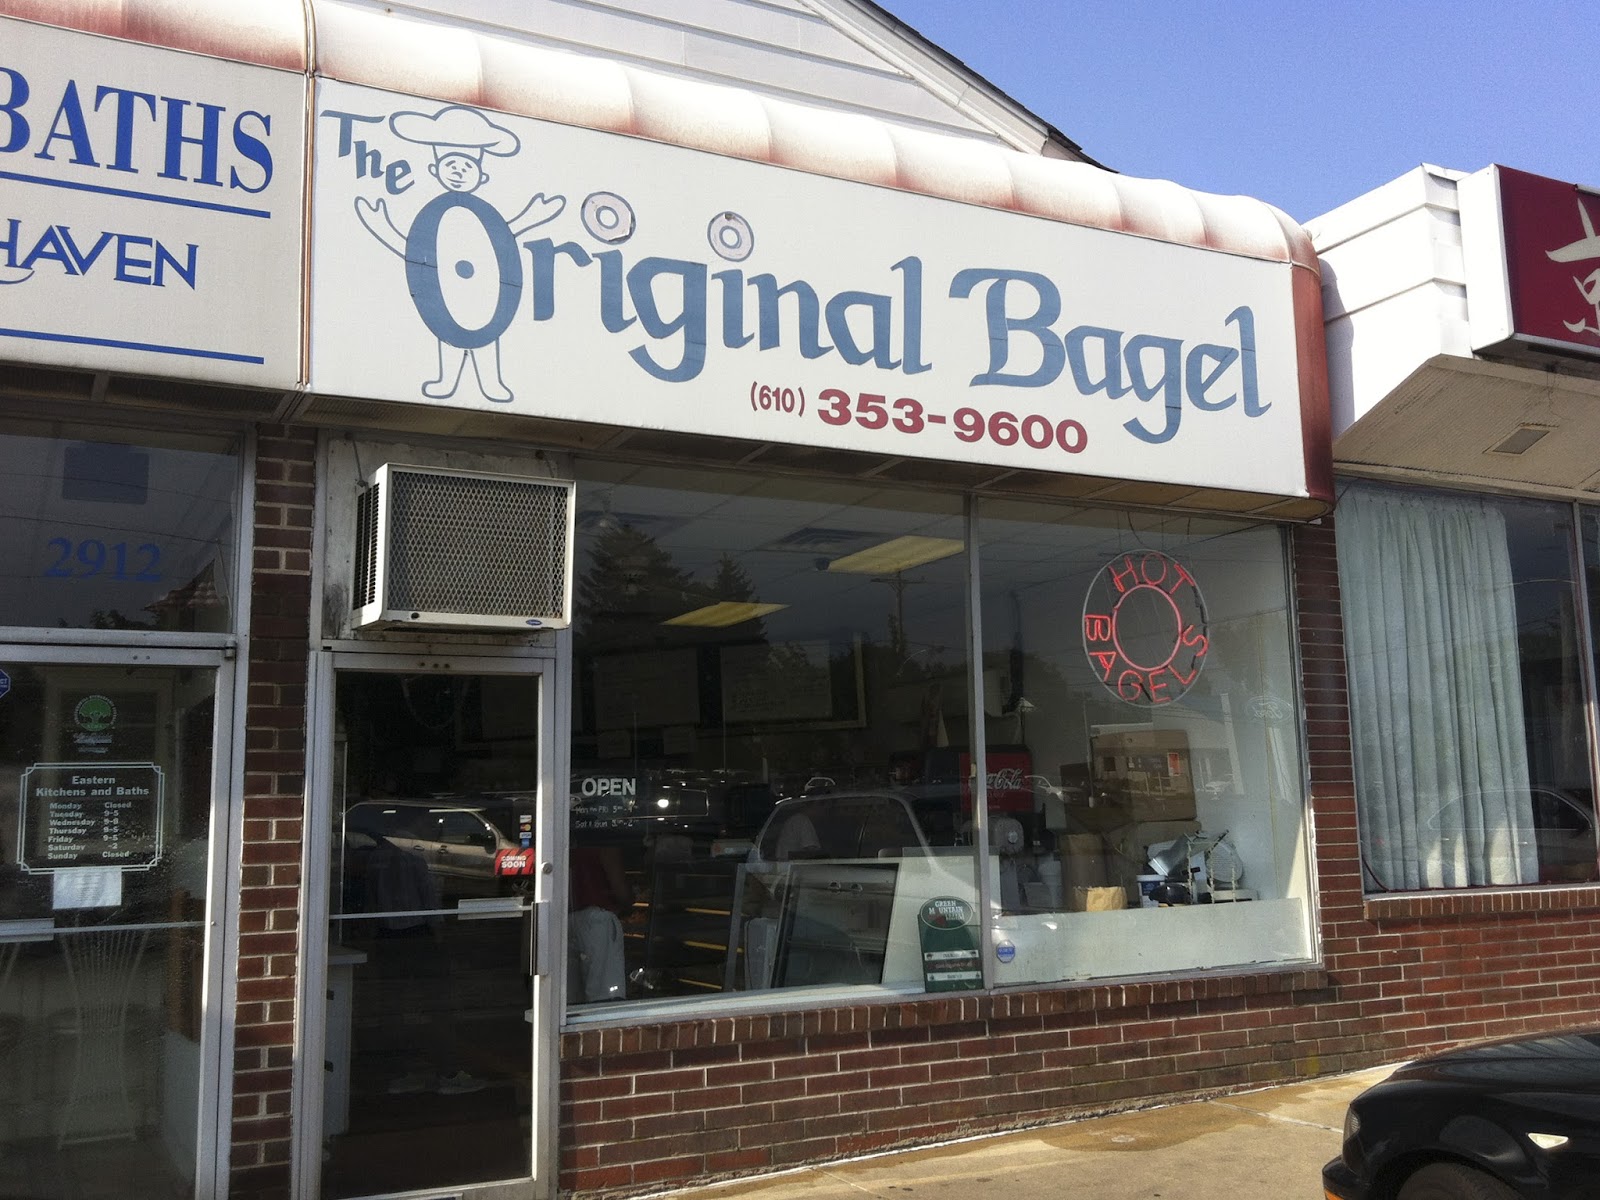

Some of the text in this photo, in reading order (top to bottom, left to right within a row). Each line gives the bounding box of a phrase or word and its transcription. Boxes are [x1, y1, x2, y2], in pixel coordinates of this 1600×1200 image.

[0, 67, 273, 194] BATHS
[320, 109, 1272, 444] The Original Bagel
[750, 381, 1088, 454] (610) 353-9600
[46, 537, 162, 583] 2912
[1108, 553, 1195, 595] HOT
[1085, 614, 1209, 703] BAGELS
[36, 786, 149, 797] Kitchens and Baths
[72, 775, 115, 785] Eastern
[581, 777, 636, 797] OPEN
[49, 819, 95, 827] Wednesday
[48, 836, 74, 844] Friday
[928, 906, 964, 915] MUNTAIN
